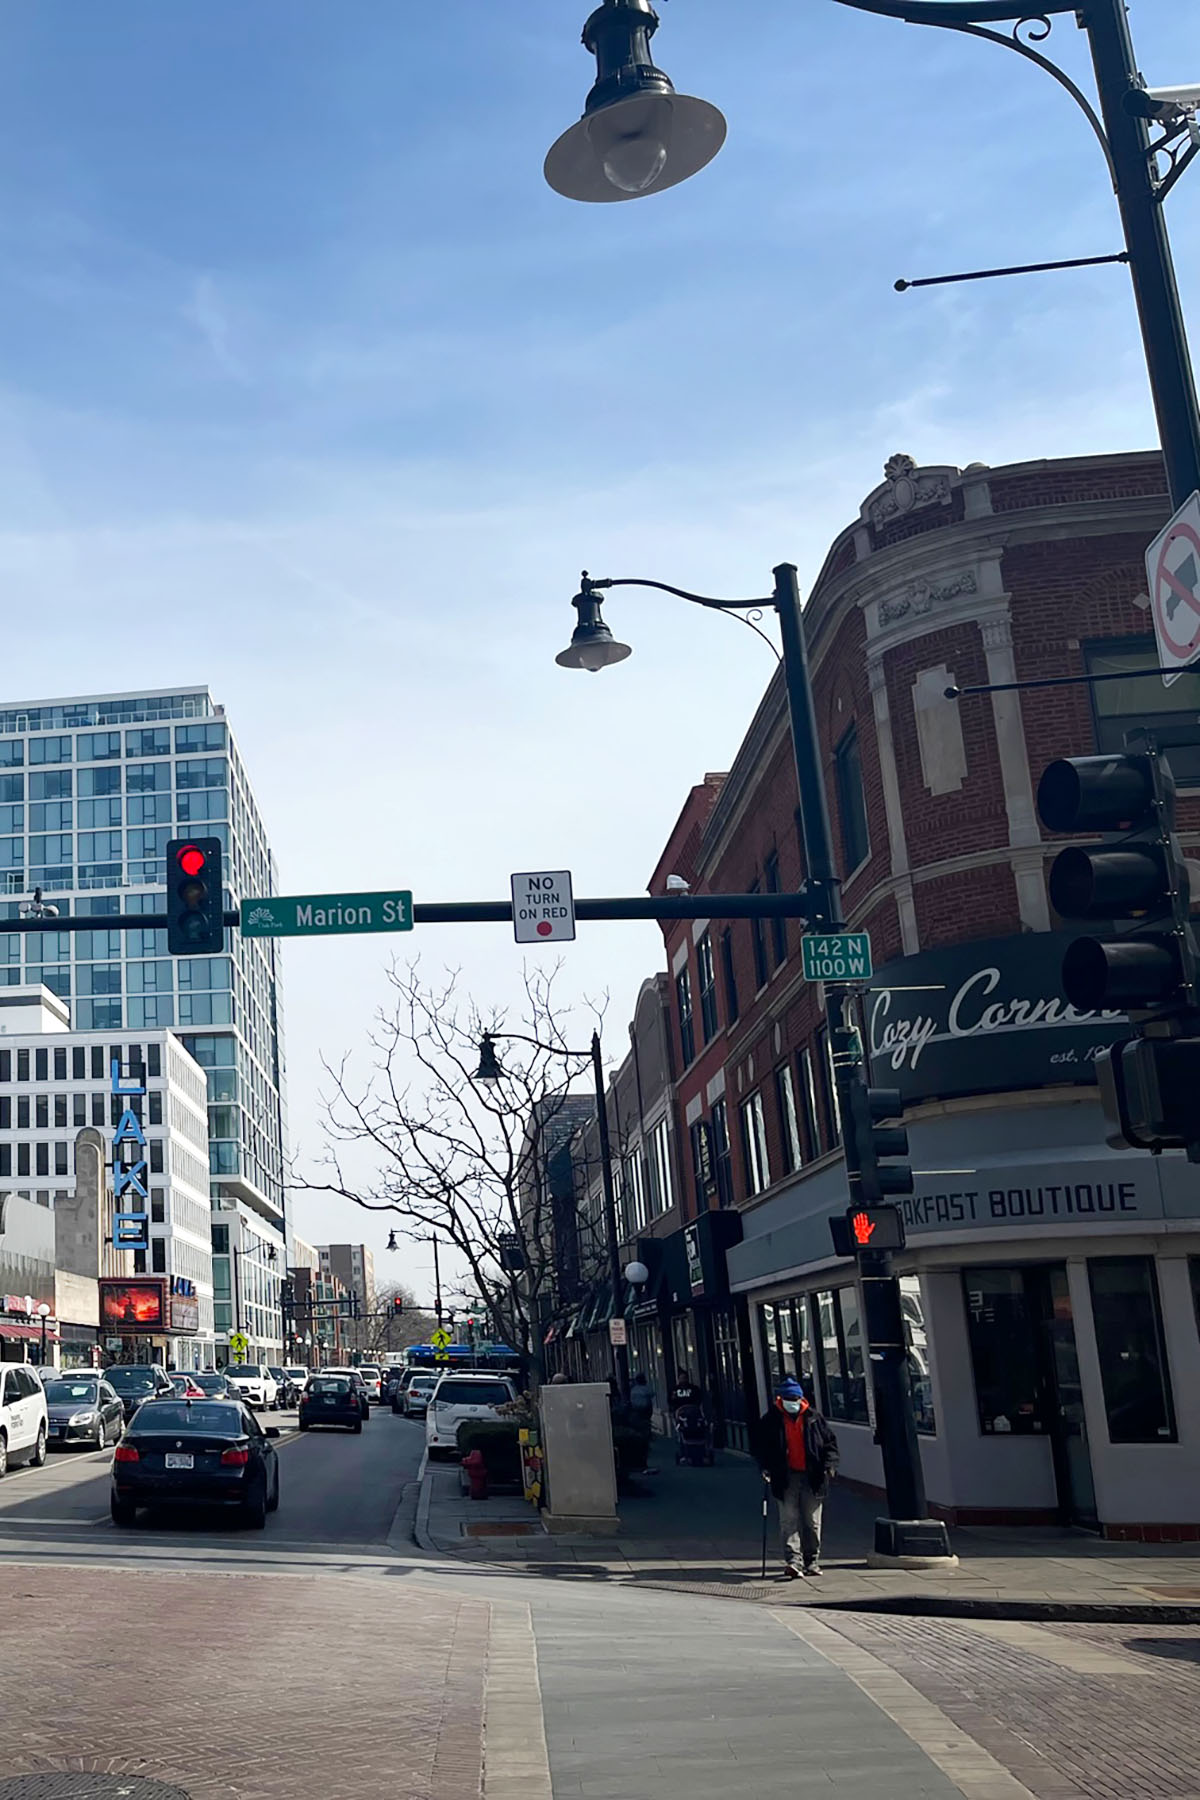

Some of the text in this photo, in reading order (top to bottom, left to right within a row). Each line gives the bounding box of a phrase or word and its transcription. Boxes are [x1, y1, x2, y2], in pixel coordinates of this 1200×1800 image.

[528, 877, 554, 891] NO
[525, 893, 560, 905] TURN
[296, 899, 405, 927] Marion St
[519, 906, 568, 920] ON RED
[809, 938, 862, 957] 142 N
[809, 957, 864, 976] 1100 W
[870, 990, 937, 1070] Cozy
[1049, 1048, 1079, 1064] est.
[111, 1058, 148, 1250] LAKE
[898, 1183, 1138, 1225] AKFAST BOUTIQUE
